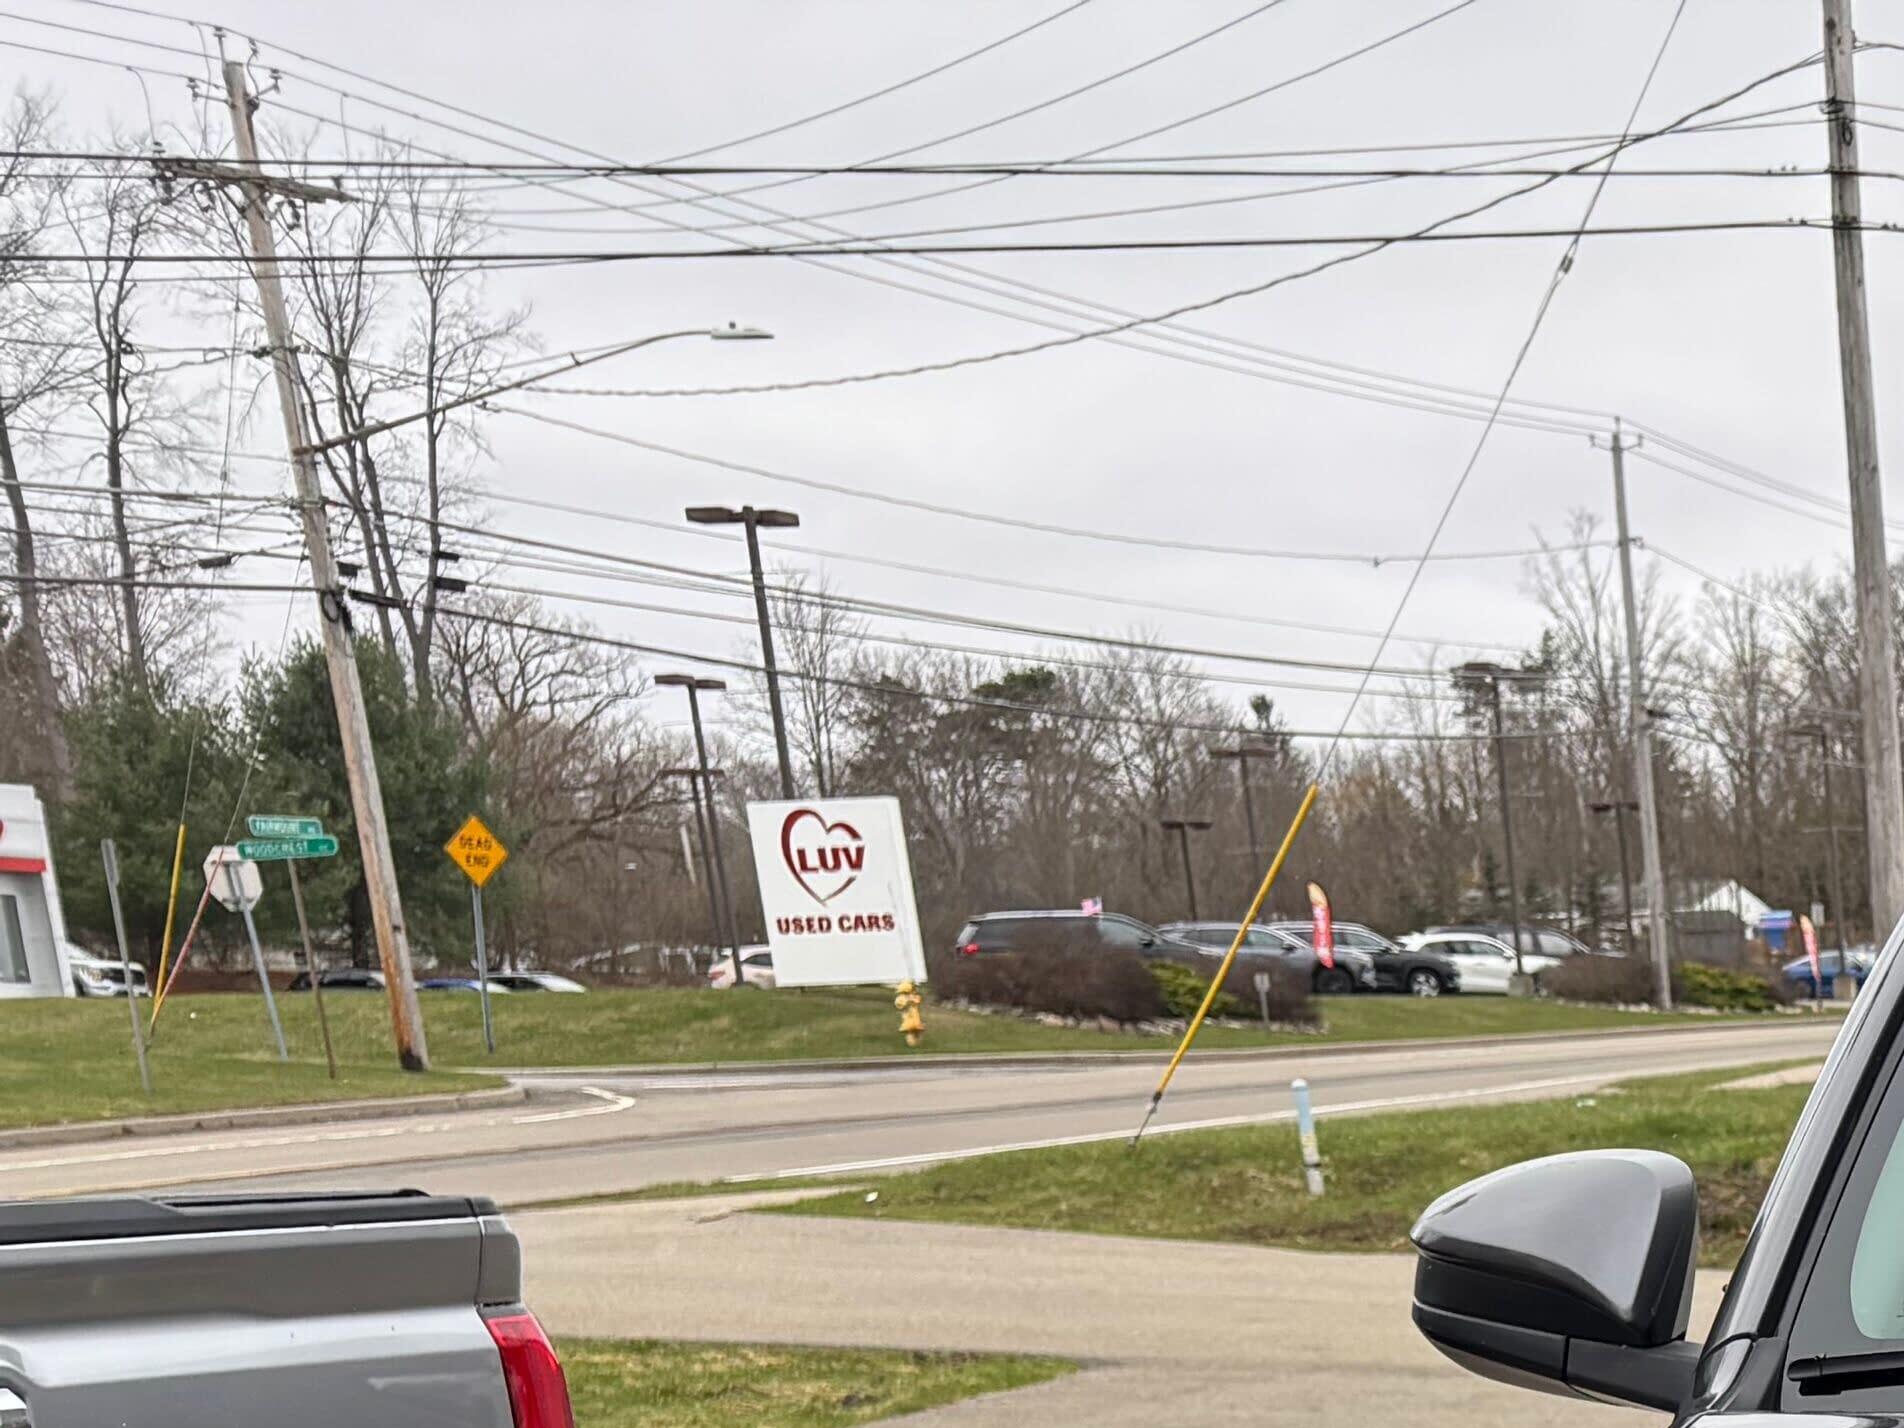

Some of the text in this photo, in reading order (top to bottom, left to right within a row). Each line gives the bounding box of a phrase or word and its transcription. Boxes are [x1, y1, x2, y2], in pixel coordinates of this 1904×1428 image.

[459, 835, 492, 851] DEAD
[465, 855, 490, 868] END
[796, 845, 866, 873] LUV
[776, 913, 896, 935] USED CARS
